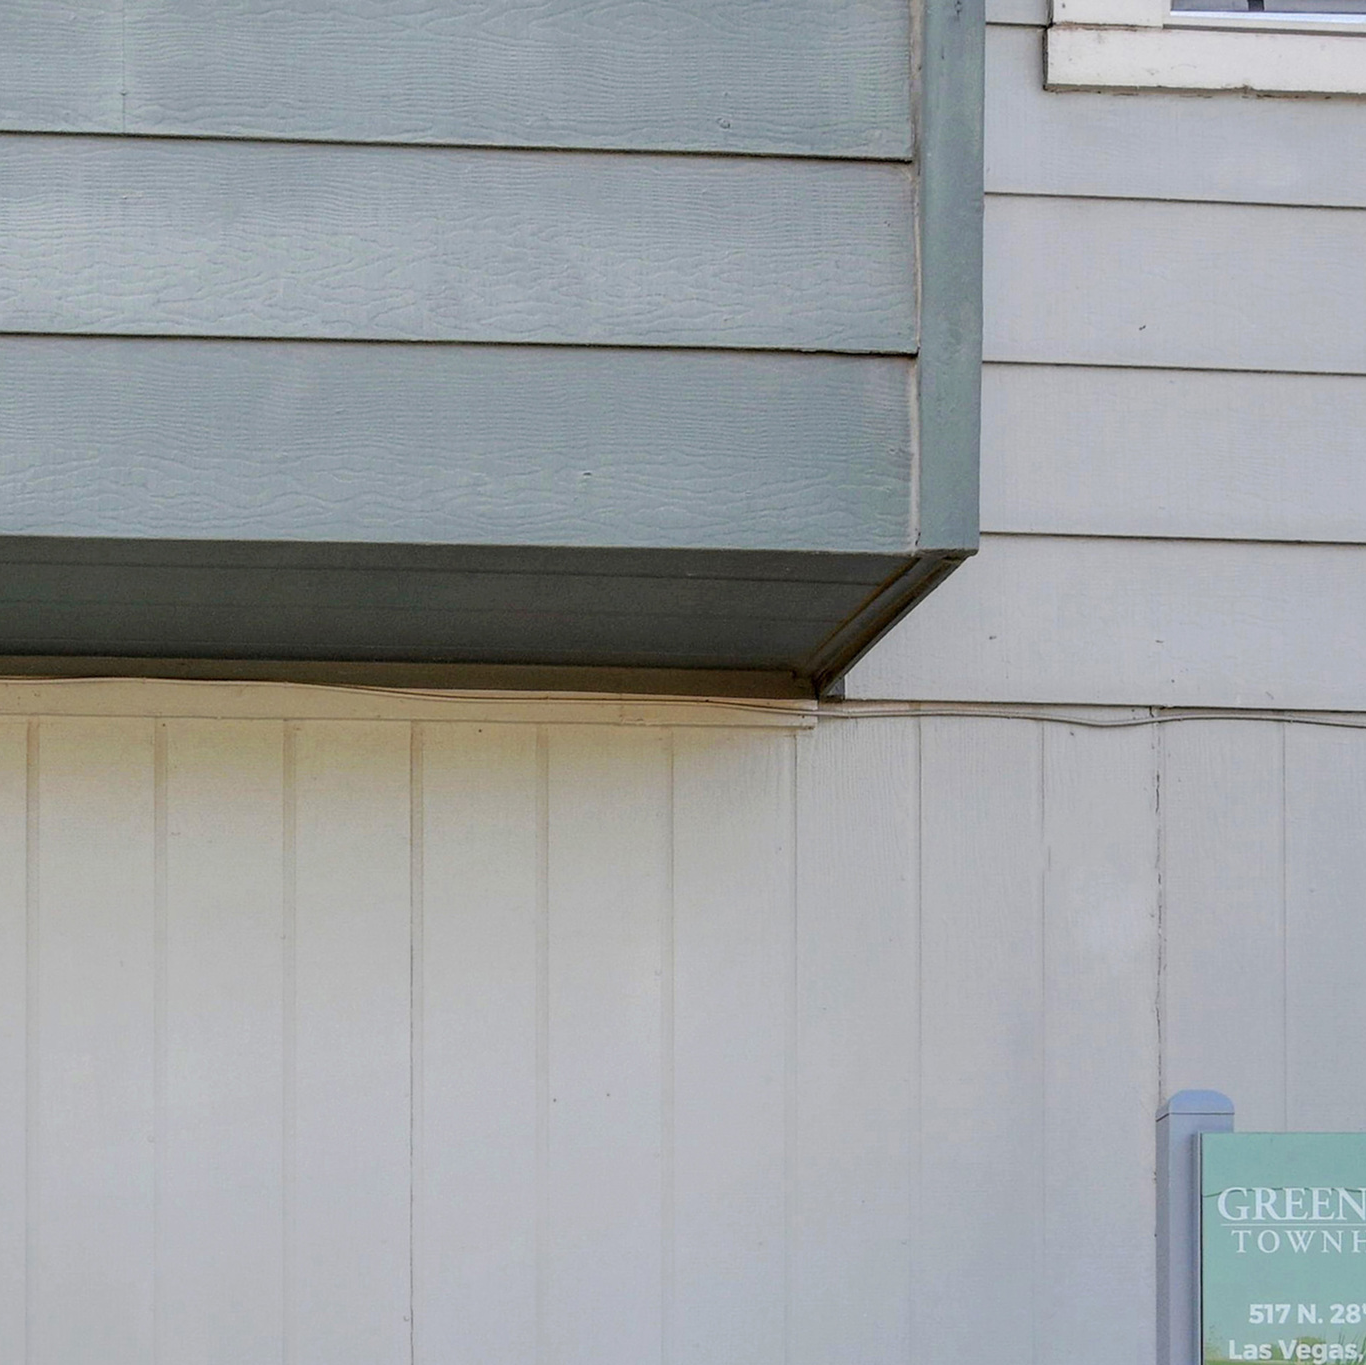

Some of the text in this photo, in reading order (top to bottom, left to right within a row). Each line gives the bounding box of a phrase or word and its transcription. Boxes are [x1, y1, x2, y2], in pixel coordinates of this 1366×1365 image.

[1249, 1304, 1291, 1324] 517
[1297, 1304, 1323, 1324] N.
[1228, 1339, 1272, 1360] Las
[1277, 1340, 1364, 1365] Vegas,
